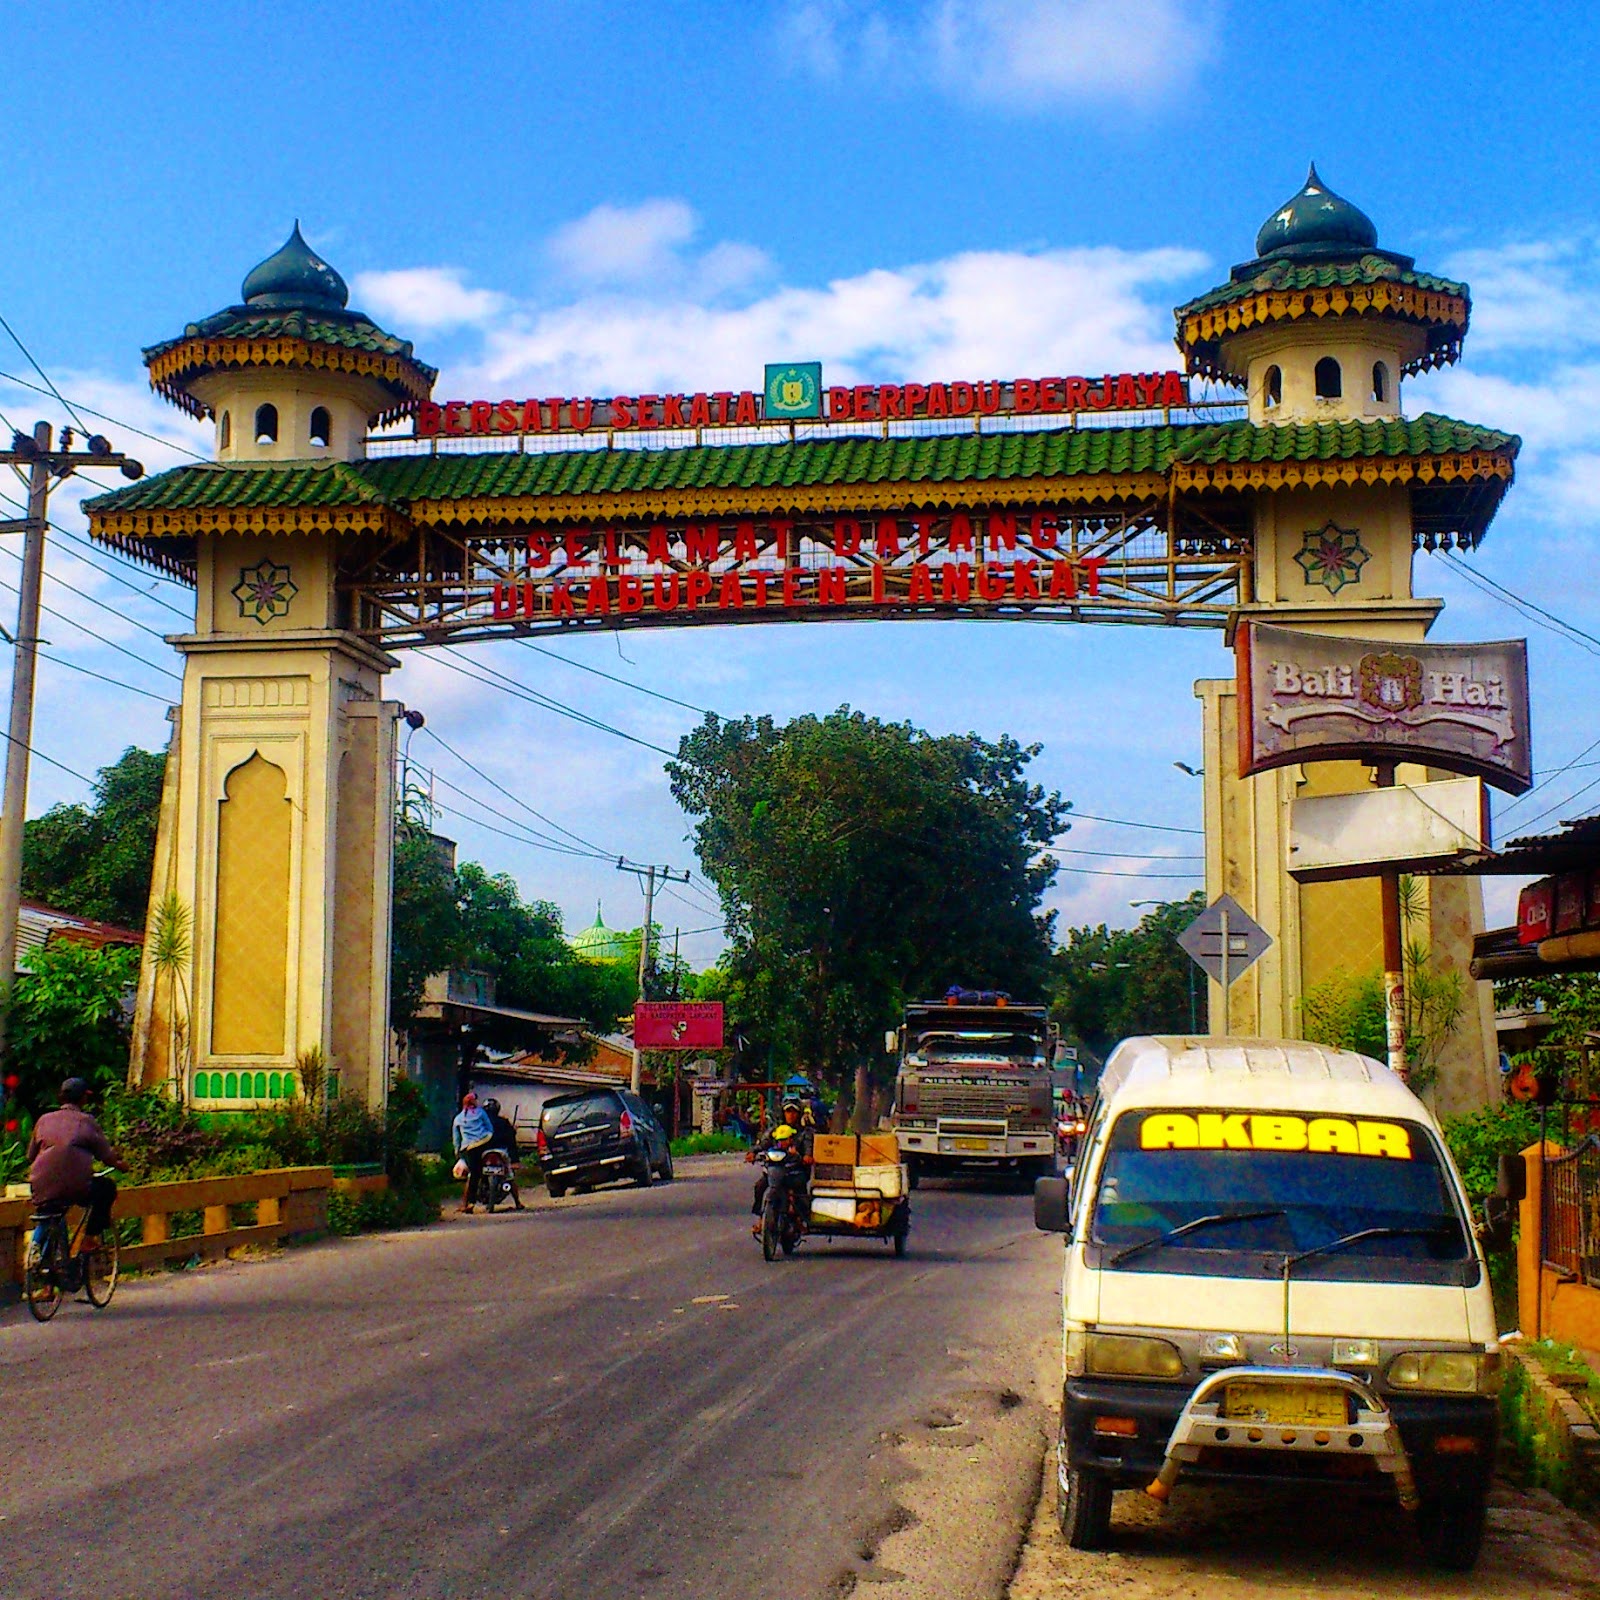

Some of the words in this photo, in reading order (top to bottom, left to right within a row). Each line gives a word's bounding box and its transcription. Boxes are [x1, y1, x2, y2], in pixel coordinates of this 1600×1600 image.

[419, 397, 593, 435] BERSATU
[610, 390, 758, 430] SEKATA
[829, 379, 1000, 420] BERPADU
[1014, 371, 1185, 413] BERJAYA
[527, 519, 795, 569] SELAMAT
[833, 511, 1059, 557] DATANG
[493, 579, 533, 619] DI
[551, 566, 846, 616] KABUPATEN
[872, 557, 1107, 605] LANGKAT
[1272, 660, 1355, 699] Bali
[1429, 669, 1507, 709] Hai
[1140, 1113, 1413, 1159] AKBAR
